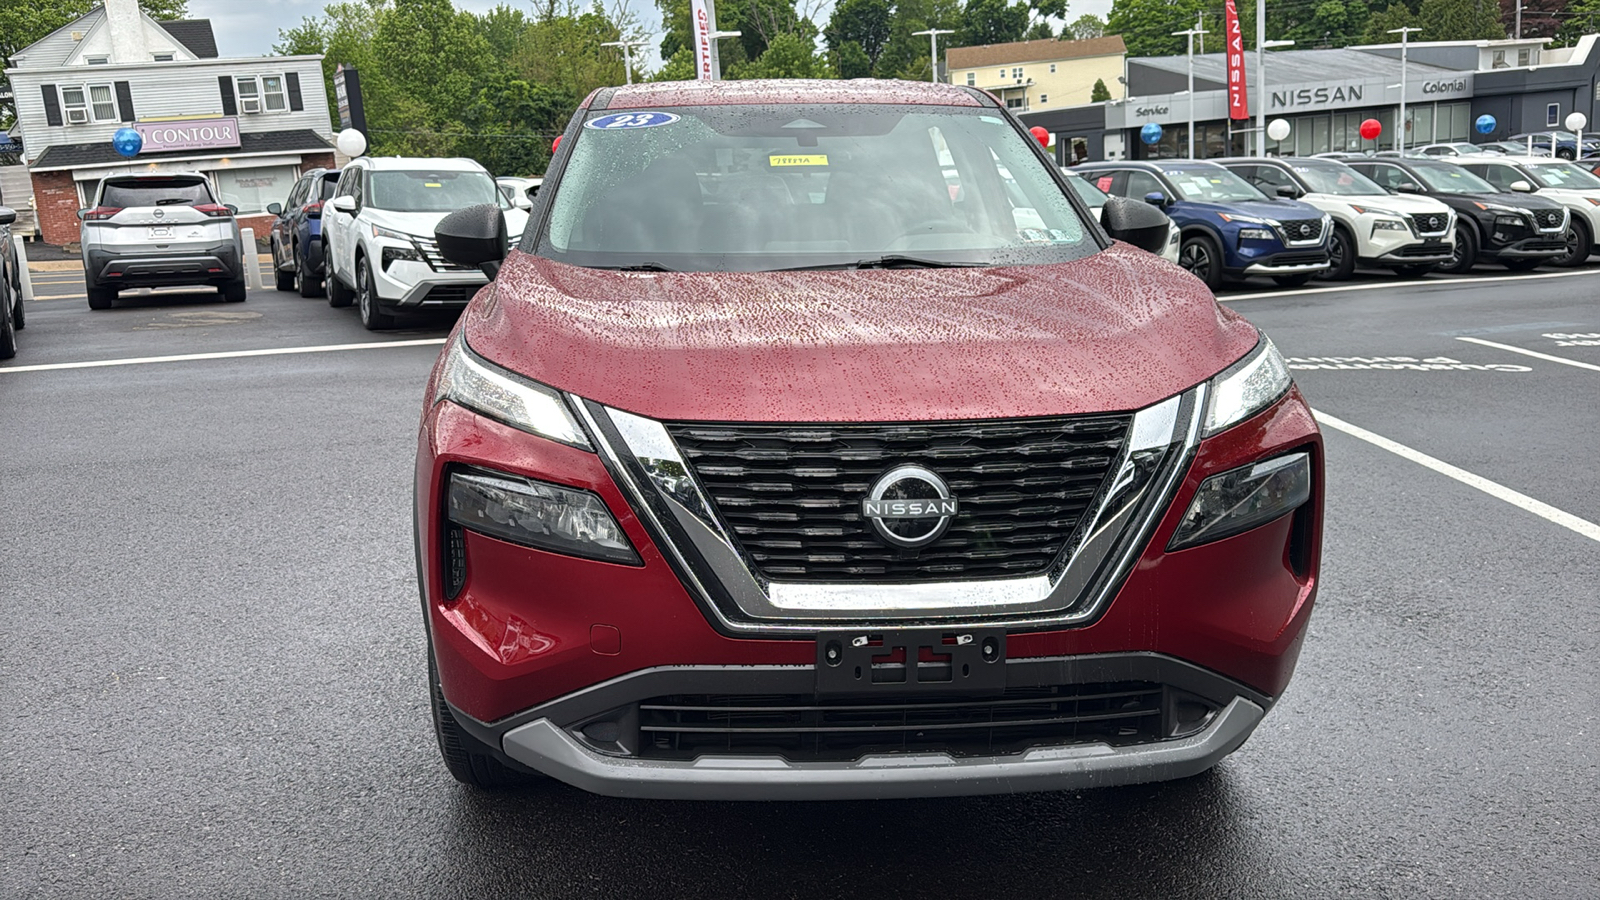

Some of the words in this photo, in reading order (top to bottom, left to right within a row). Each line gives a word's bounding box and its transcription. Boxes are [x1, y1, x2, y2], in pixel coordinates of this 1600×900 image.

[698, 9, 710, 80] ERTIFIED
[1231, 20, 1241, 107] NISSAN
[1422, 79, 1466, 94] Colonial
[1271, 85, 1363, 108] NISSAN
[1135, 105, 1169, 117] Service
[605, 114, 654, 128] 23
[152, 126, 232, 144] CONTOUR
[866, 501, 955, 515] NISSAN
